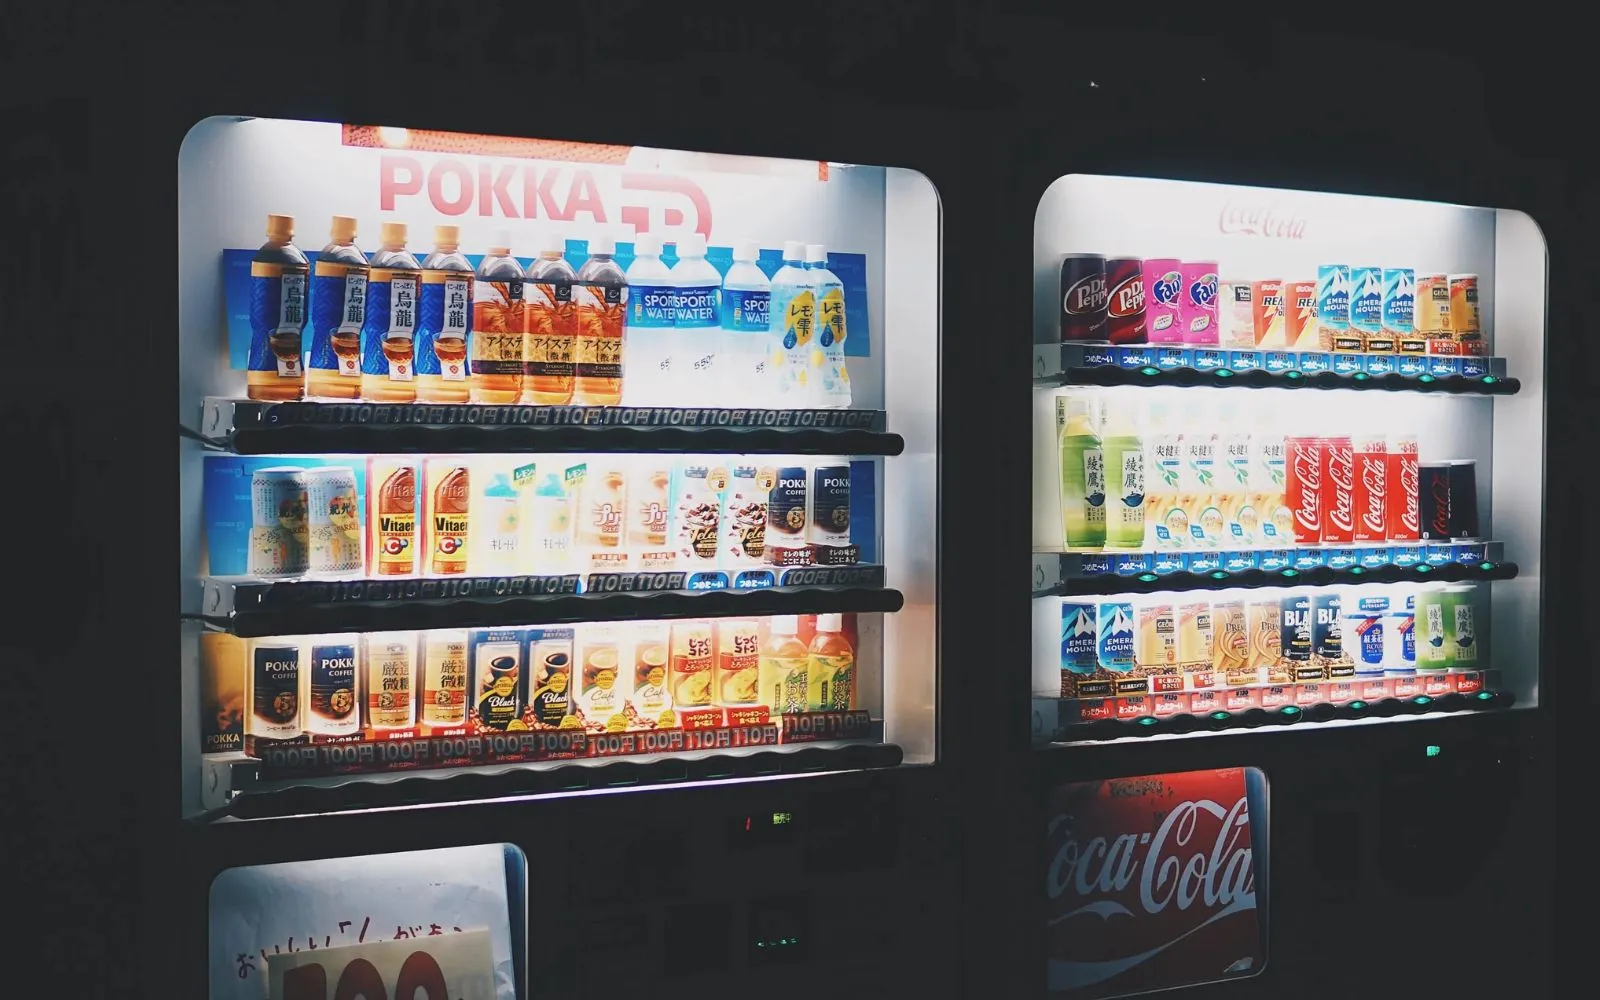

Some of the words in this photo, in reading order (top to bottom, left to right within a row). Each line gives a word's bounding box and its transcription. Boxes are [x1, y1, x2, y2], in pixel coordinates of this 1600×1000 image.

[380, 155, 607, 223] POKKA
[285, 287, 303, 323] 烏龍
[347, 287, 364, 323] 烏龍
[395, 291, 413, 328] 烏龍
[448, 292, 465, 328] 烏龍
[675, 295, 716, 308] SPORTS
[676, 307, 713, 320] WATER
[449, 406, 497, 424] 110円
[502, 407, 549, 424] 110円
[553, 407, 600, 424] 110円
[604, 408, 649, 425] 110円
[653, 408, 698, 425] 110円
[701, 409, 746, 425] 110円
[747, 410, 794, 426] 110円
[1294, 441, 1320, 531] Coca-Cola
[1328, 443, 1353, 532] Coca-Cola
[1362, 455, 1385, 533] Coca-Cola
[440, 579, 491, 597] 110円
[529, 576, 578, 594] 110円
[588, 574, 634, 592] 110円
[637, 573, 684, 590] 110円
[787, 571, 828, 585] 100円
[488, 695, 515, 707] Black
[541, 692, 568, 704] Black
[783, 714, 826, 735] 110円
[486, 733, 535, 756] 100円
[538, 731, 586, 754] 100円
[588, 731, 635, 756] 100円
[638, 729, 684, 751] 100円
[685, 727, 731, 750] 110円
[732, 725, 777, 747] 110円
[319, 743, 374, 764] 100円
[378, 739, 430, 761] 100円
[433, 736, 482, 760] 100円
